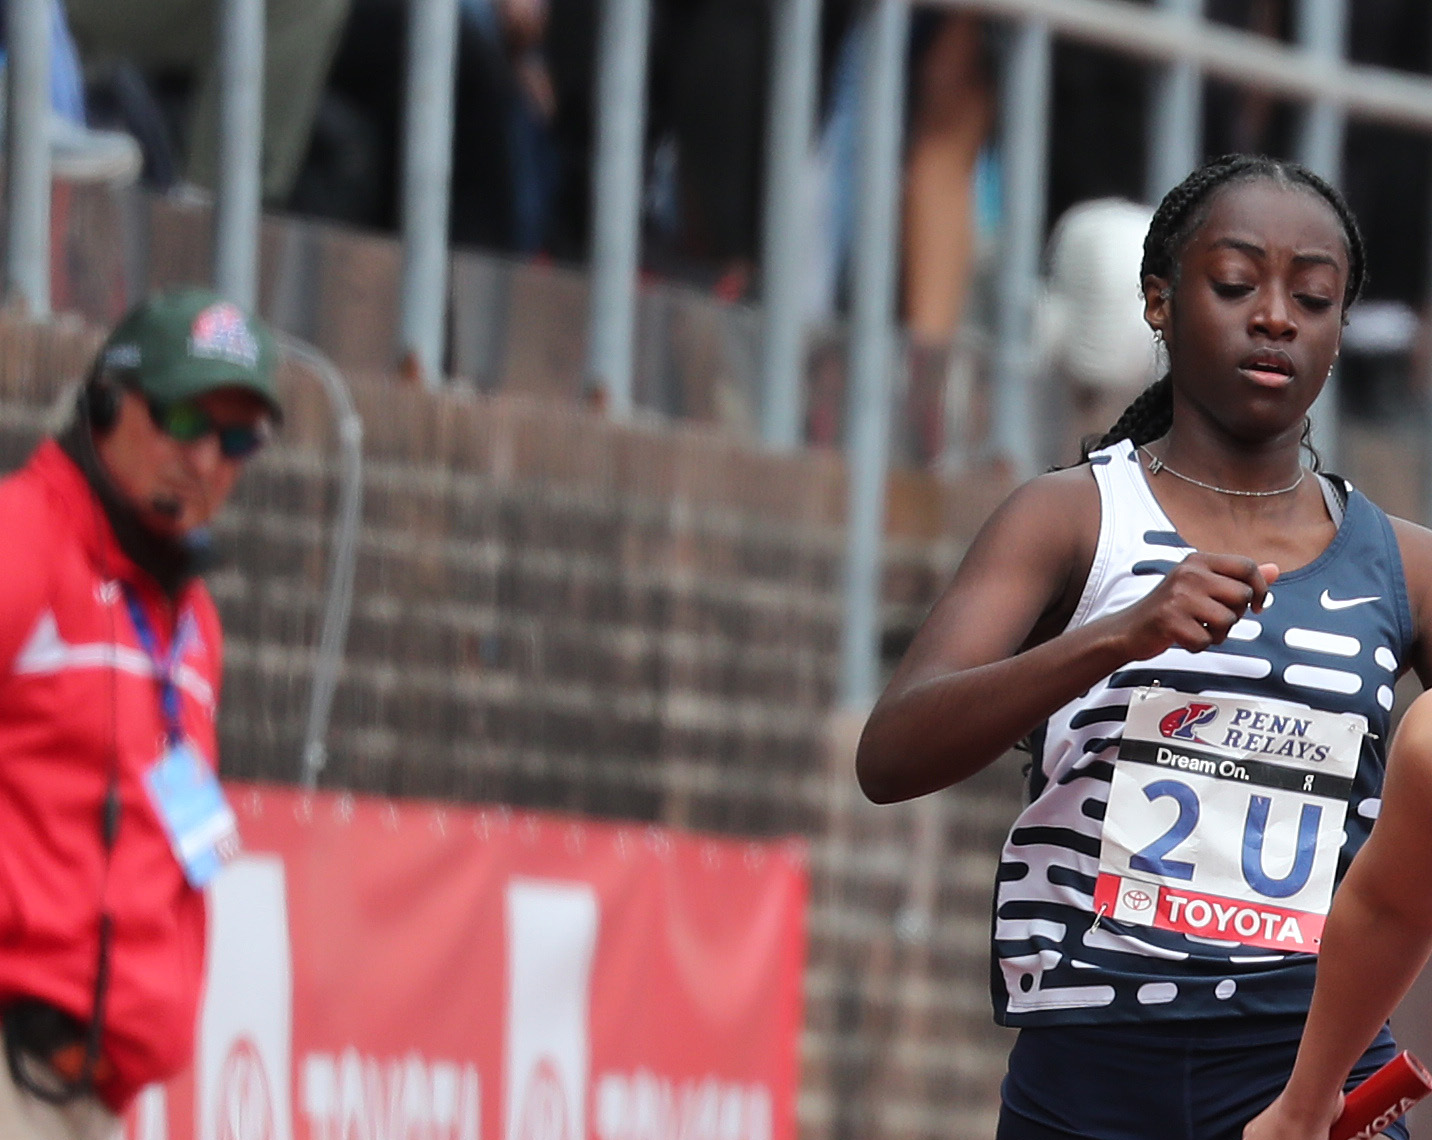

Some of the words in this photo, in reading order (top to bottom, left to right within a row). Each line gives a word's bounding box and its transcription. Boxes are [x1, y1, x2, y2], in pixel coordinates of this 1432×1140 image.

[1231, 708, 1313, 738] PENN
[1221, 728, 1331, 763] RELAYS
[1156, 747, 1216, 775] Dream
[1219, 761, 1250, 781] On.
[1165, 895, 1304, 944] TOYOTA
